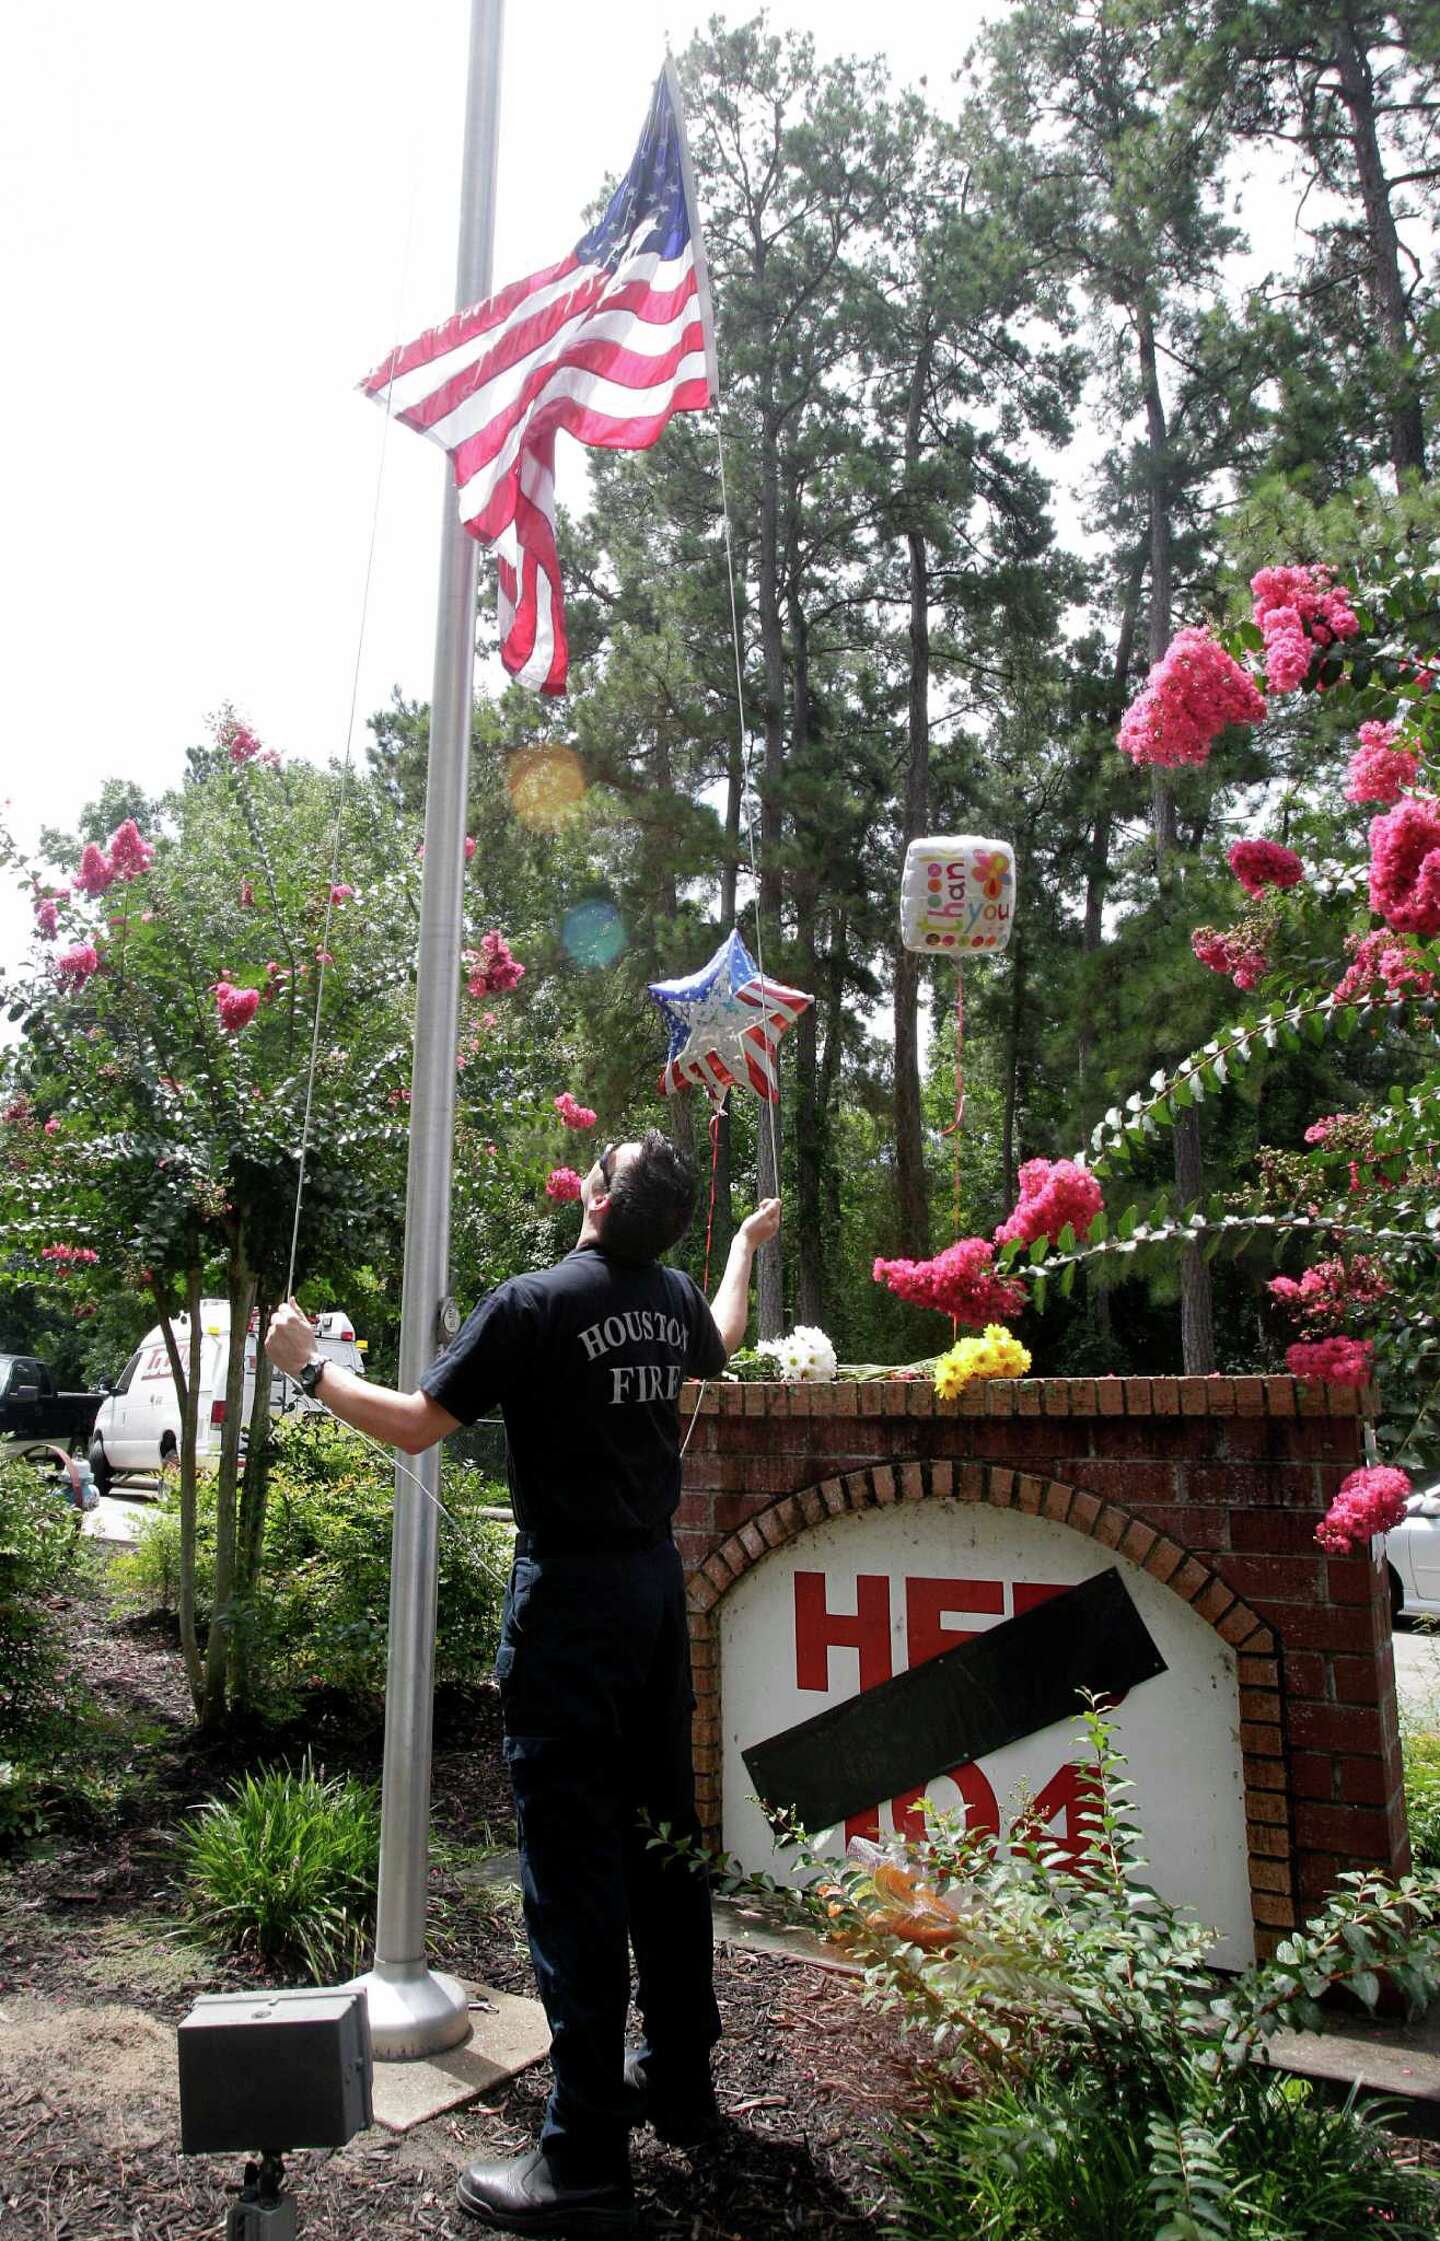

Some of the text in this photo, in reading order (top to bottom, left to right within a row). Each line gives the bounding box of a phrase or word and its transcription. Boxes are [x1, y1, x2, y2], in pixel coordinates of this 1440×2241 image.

[963, 903, 1010, 934] you
[608, 1365, 681, 1404] FIRE
[845, 1761, 1121, 1895] 04
